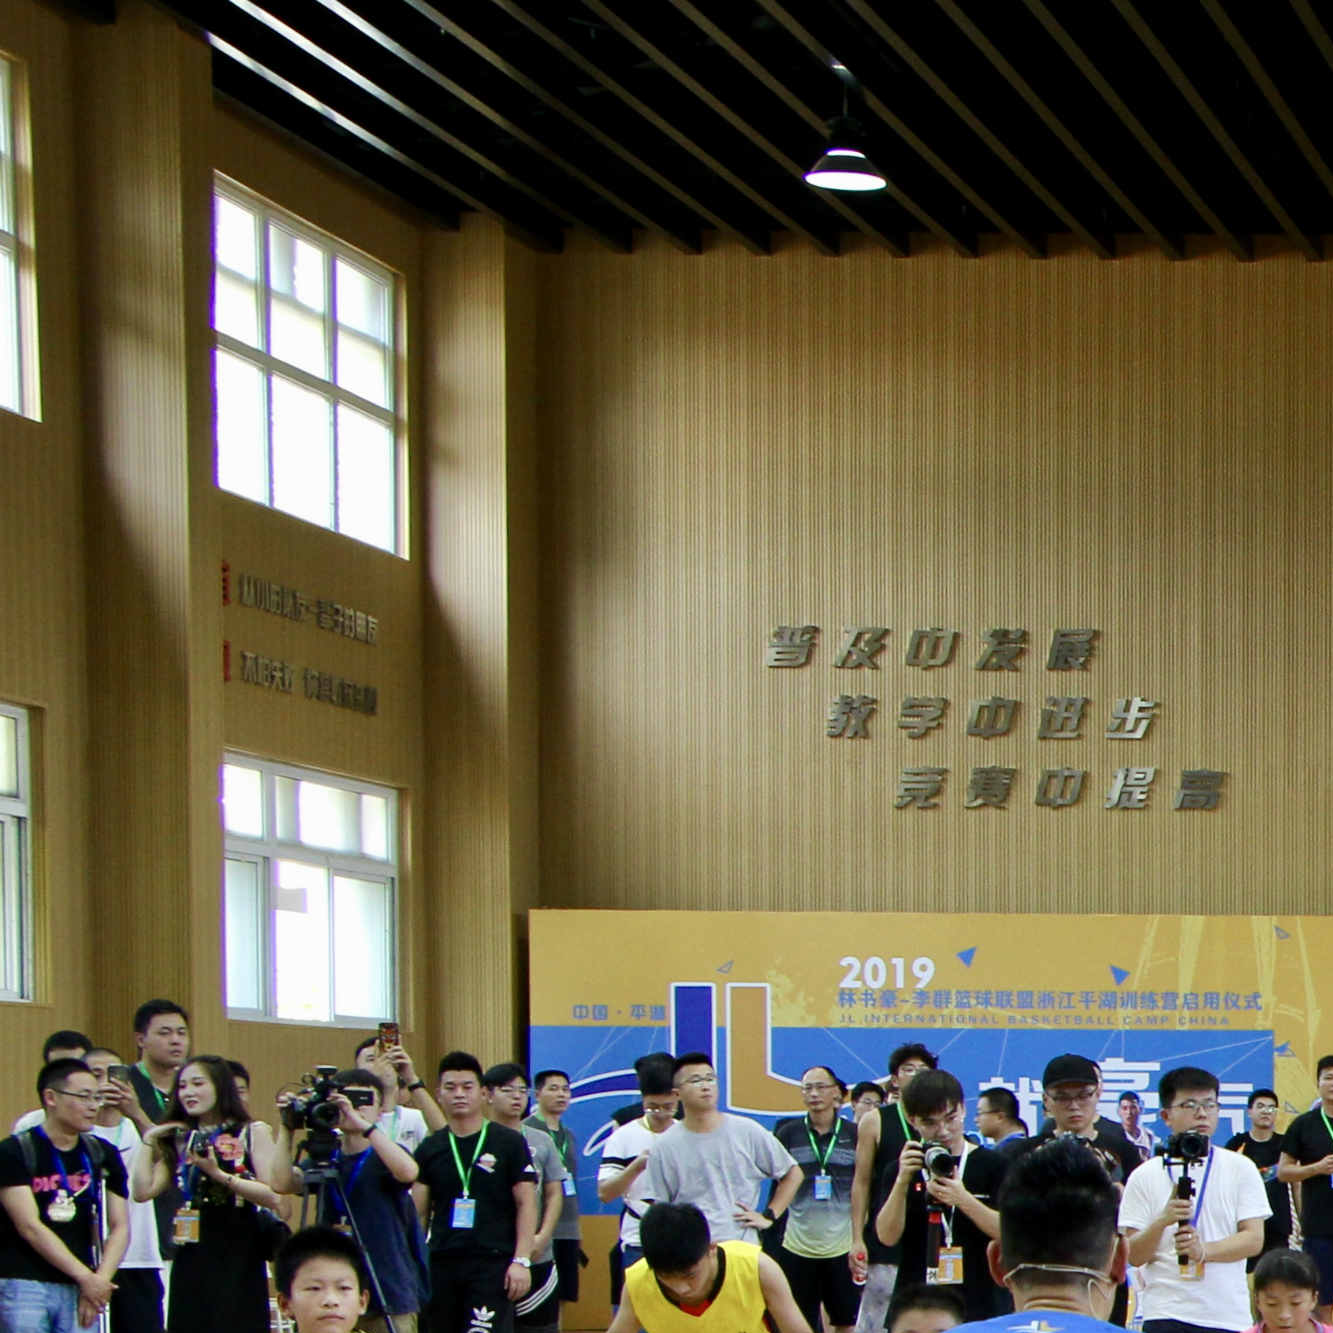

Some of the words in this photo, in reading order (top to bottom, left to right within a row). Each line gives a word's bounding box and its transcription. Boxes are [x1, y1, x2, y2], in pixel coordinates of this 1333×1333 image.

[767, 625, 1101, 671] 普及中发展
[826, 695, 1162, 740] 教学中进步
[894, 766, 1230, 810] 竞赛中提高
[839, 956, 935, 989] 2019
[839, 1013, 856, 1024] JL
[864, 1013, 1000, 1025] INTERNATIONAL
[1007, 1014, 1114, 1026] BASKETBALL
[1123, 1015, 1170, 1026] CAMP
[1178, 1015, 1230, 1026] CHINA
